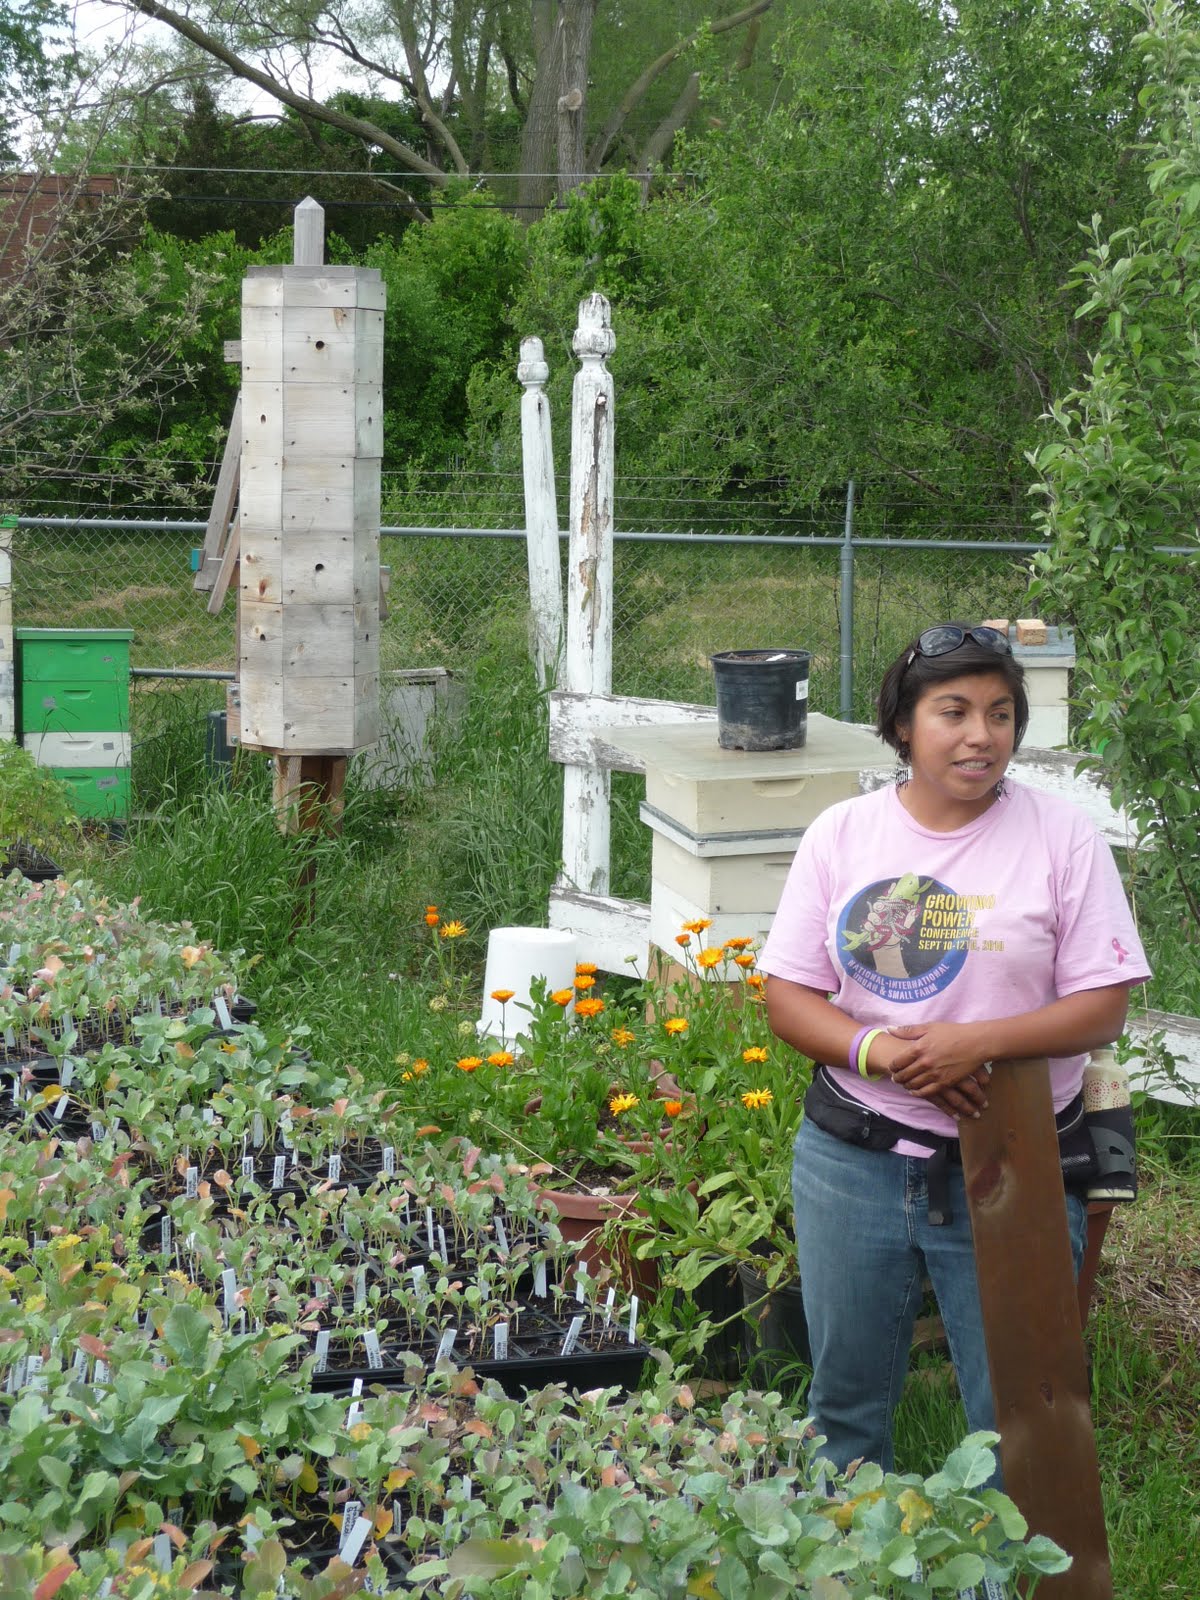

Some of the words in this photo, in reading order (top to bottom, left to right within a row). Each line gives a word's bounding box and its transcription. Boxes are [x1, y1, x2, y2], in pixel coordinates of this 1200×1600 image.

[922, 909, 976, 928] POWER
[920, 926, 979, 939] CONFERENCE
[918, 939, 941, 950] SEPT
[879, 985, 887, 996] &
[887, 989, 914, 1000] SMALL
[914, 983, 939, 998] FARM
